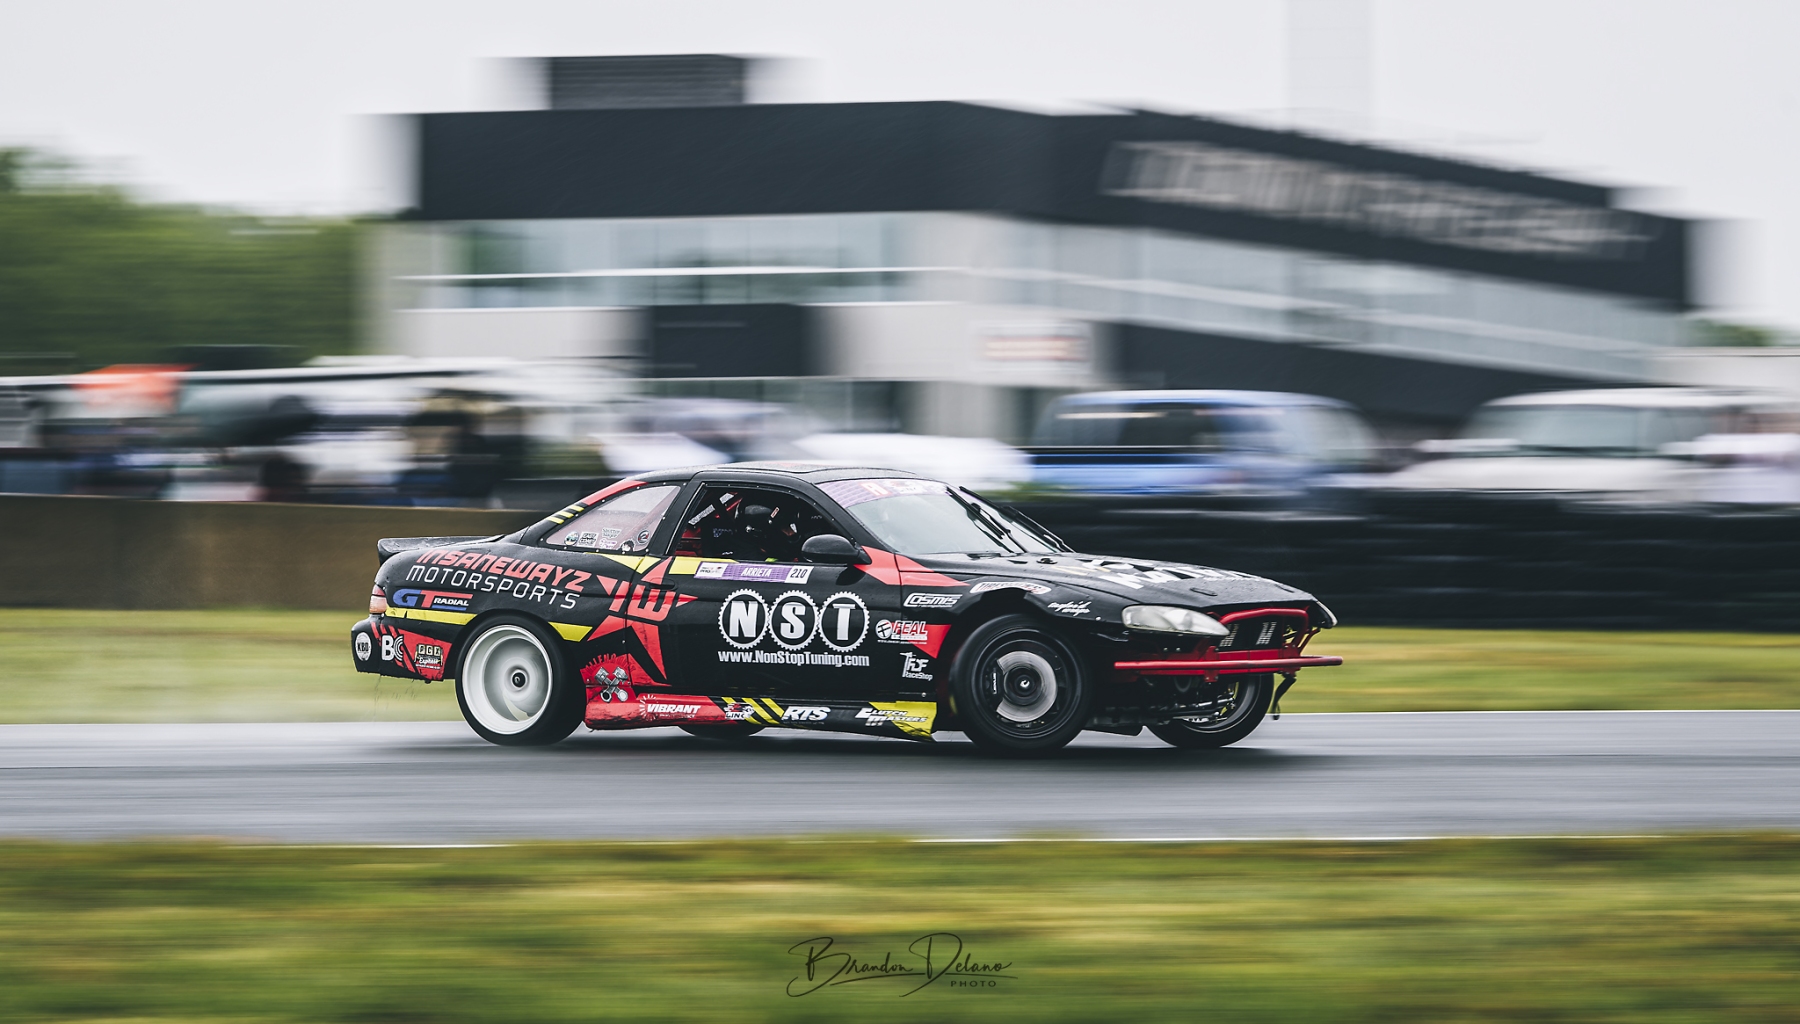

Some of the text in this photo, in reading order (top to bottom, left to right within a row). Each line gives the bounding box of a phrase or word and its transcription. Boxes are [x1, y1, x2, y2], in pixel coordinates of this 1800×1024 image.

[416, 549, 592, 592] INSANEWAYZ
[741, 567, 808, 579] ARRIETA 210
[406, 565, 581, 610] MOTORSPORTS
[393, 588, 474, 609] GT RADIAL
[893, 620, 928, 635] FEAL
[381, 634, 404, 662] BC
[718, 651, 870, 668] www.NonStopTuning.com
[647, 703, 702, 714] VIBRANT
[781, 706, 832, 721] RTS
